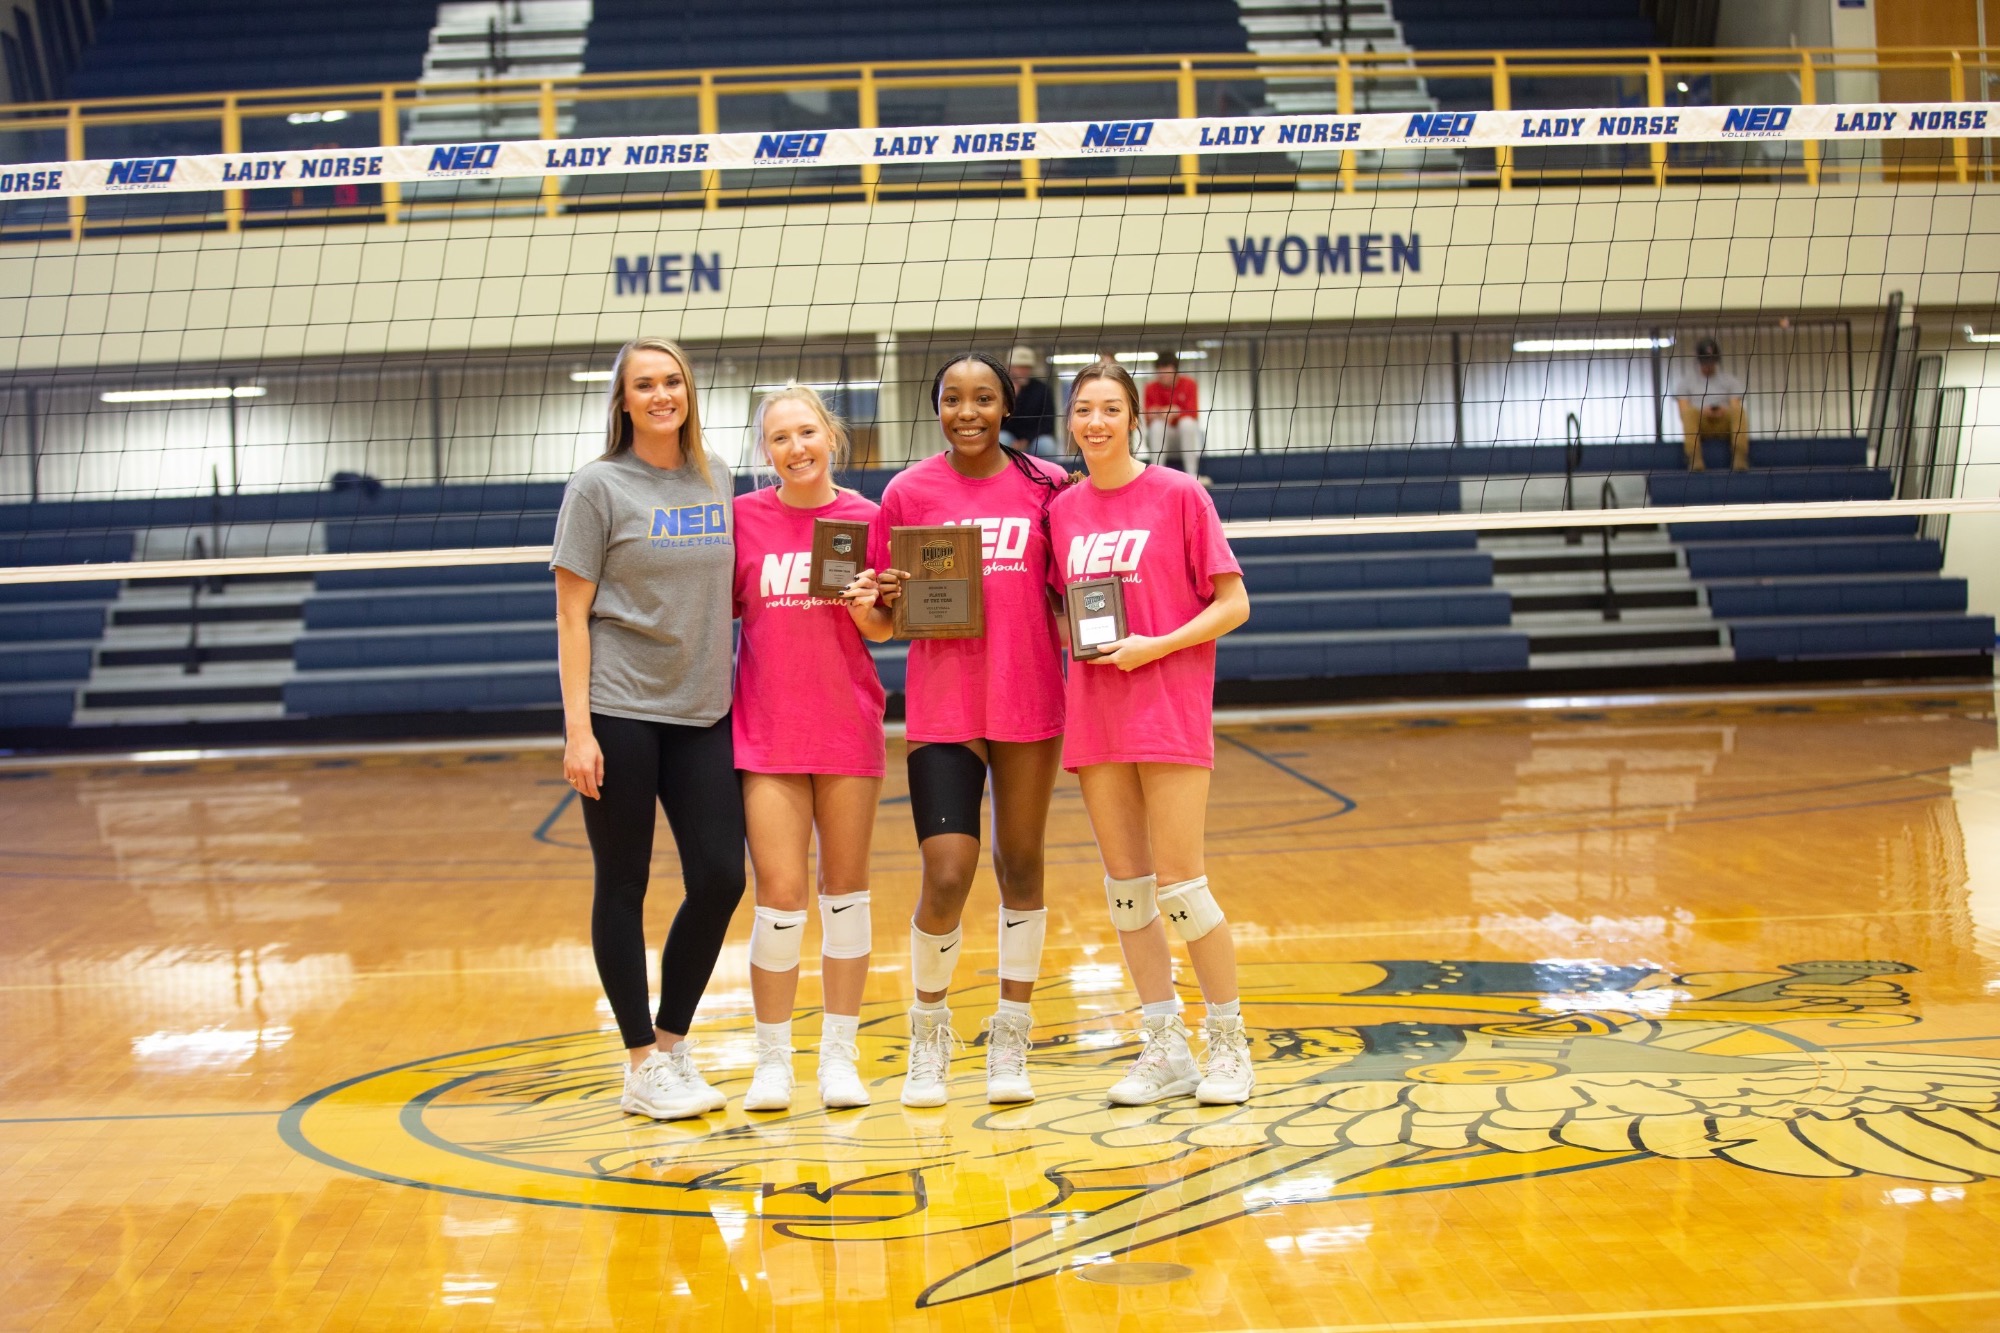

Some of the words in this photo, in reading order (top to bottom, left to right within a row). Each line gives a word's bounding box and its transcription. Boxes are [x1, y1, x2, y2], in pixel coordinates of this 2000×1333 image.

[1405, 113, 1477, 137] NEO
[1521, 118, 1586, 138] LADY
[1597, 115, 1680, 136] NORSE
[1722, 107, 1792, 131] NEO
[1836, 112, 1897, 131] LADY
[1908, 110, 1988, 130] NORSE
[755, 133, 827, 158] NEO
[873, 136, 939, 157] LADY
[952, 132, 1037, 154] NORSE
[1082, 122, 1154, 147] NEO
[1200, 125, 1265, 146] LADY
[1278, 122, 1361, 143] NORSE
[428, 144, 500, 170] NEO
[546, 147, 611, 168] LADY
[625, 143, 709, 165] NORSE
[753, 157, 818, 165] VOLLEYBALL
[1080, 146, 1145, 154] VOLLEYBALL
[107, 159, 177, 184] NEO
[222, 161, 286, 182] LADY
[300, 156, 383, 179] NORSE
[427, 169, 491, 177] VOLLEYBALL
[0, 171, 63, 193] ORSE
[105, 183, 168, 191] VOLLEYBALL
[1228, 233, 1421, 276] WOMEN
[615, 252, 721, 295] MEN
[648, 502, 728, 538] NEO
[651, 535, 732, 548] VOLLEYBALL
[943, 517, 1031, 560] EO
[1067, 529, 1151, 579] NEO
[760, 552, 812, 597] NE
